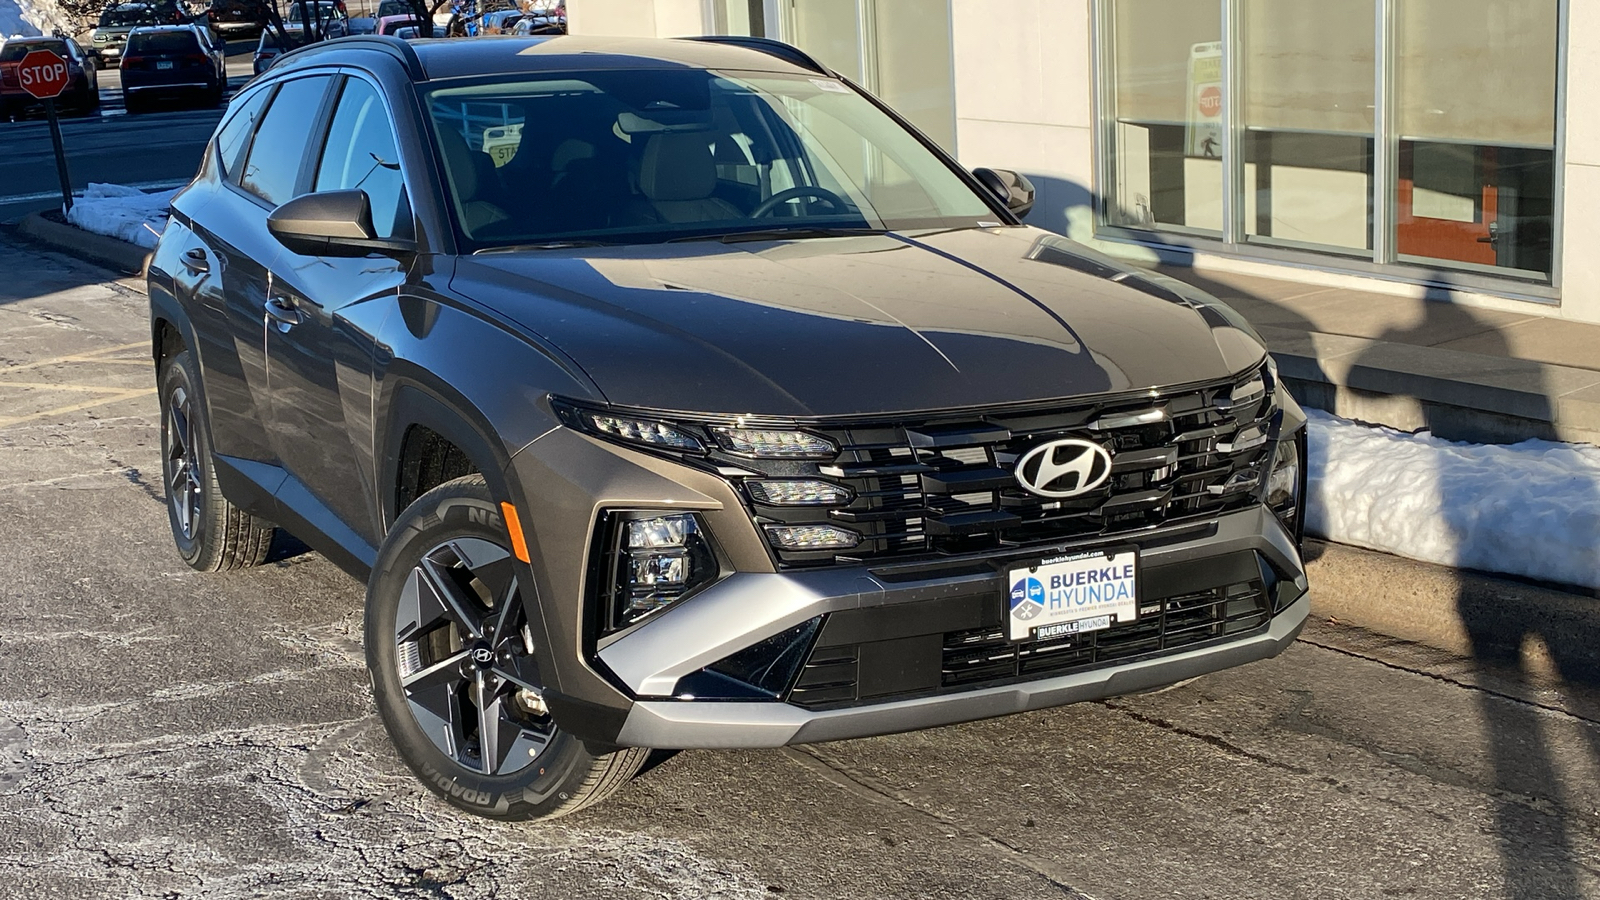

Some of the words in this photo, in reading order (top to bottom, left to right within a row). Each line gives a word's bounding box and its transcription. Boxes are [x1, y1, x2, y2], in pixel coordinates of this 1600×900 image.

[22, 63, 64, 85] STOP
[1041, 551, 1104, 565] buerklehyundai.com
[1050, 564, 1134, 590] BUERKLE
[1050, 580, 1134, 610] HYUNDAI
[1039, 622, 1078, 638] BUERKLE
[1079, 618, 1109, 631] HYUNDAI
